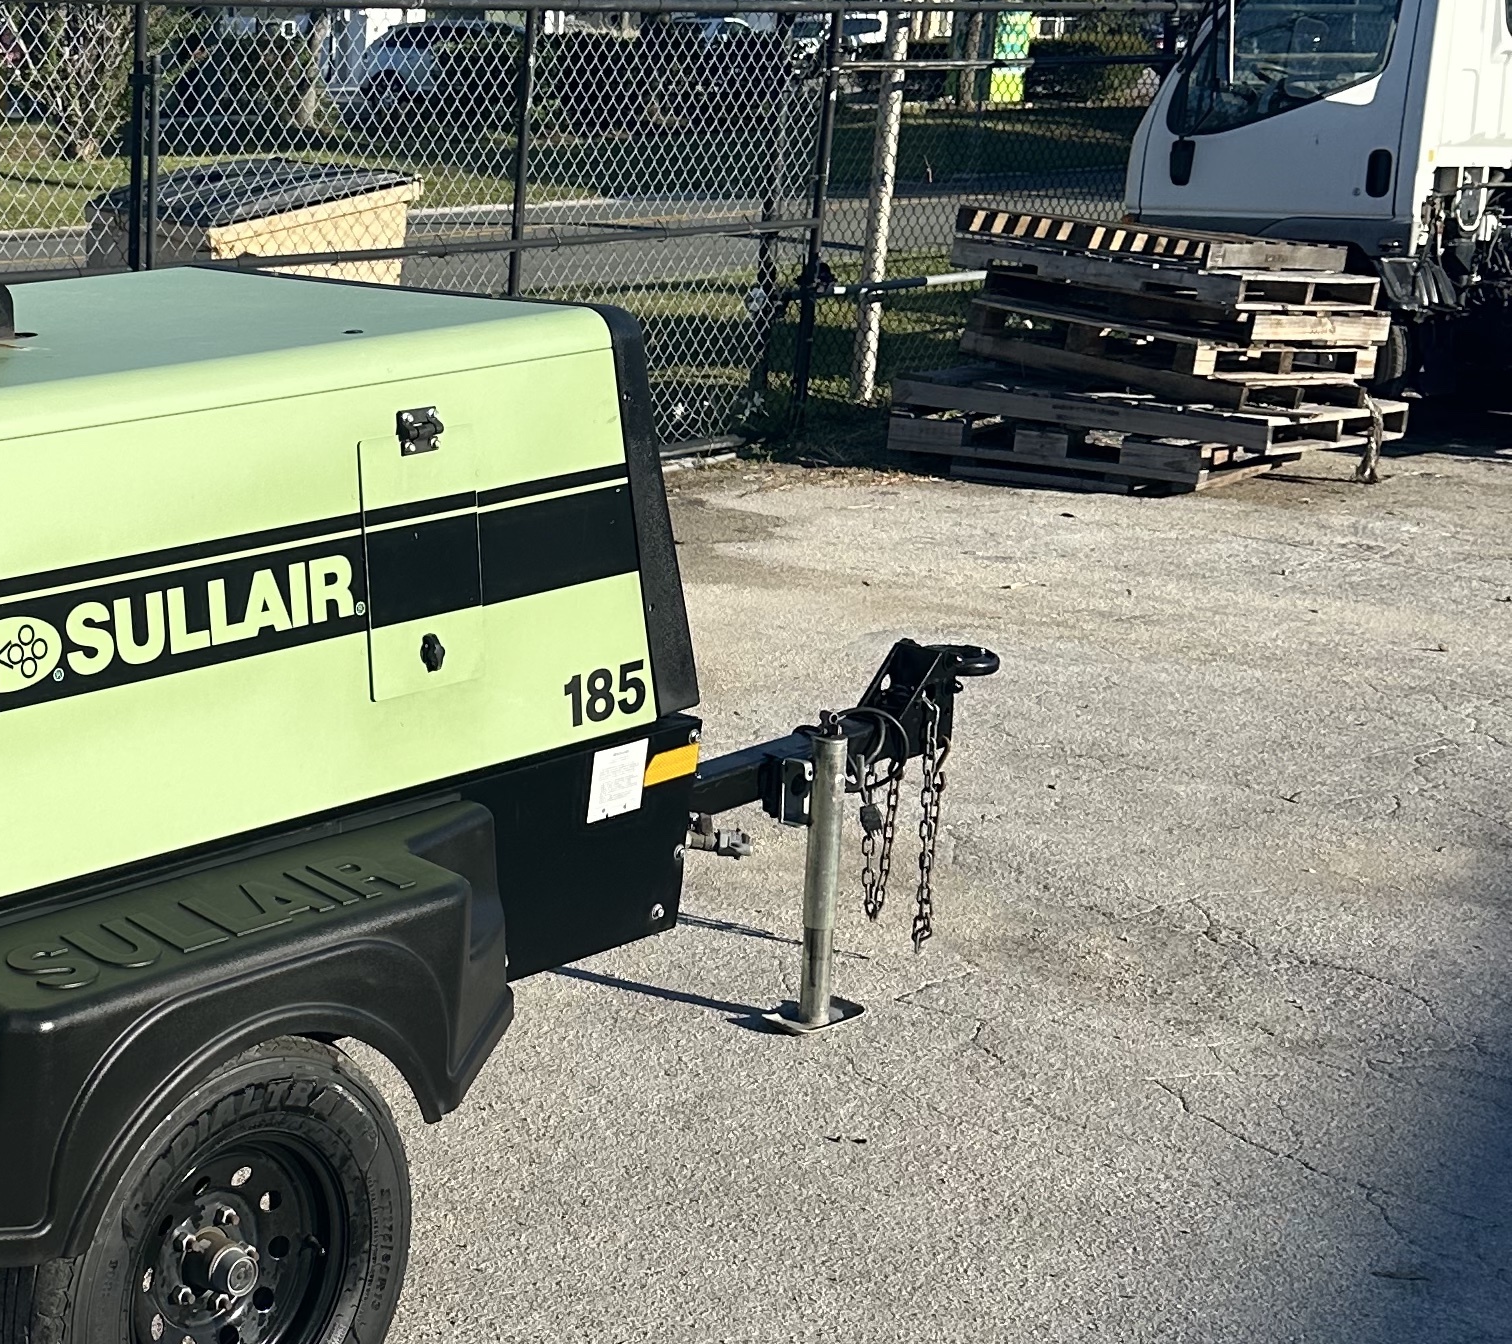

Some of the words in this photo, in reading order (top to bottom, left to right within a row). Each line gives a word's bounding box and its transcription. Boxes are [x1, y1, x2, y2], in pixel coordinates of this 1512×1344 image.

[65, 554, 355, 676] SULLAIR
[564, 659, 646, 727] 185
[6, 858, 416, 989] SULLAIR
[127, 1083, 261, 1226] RADIAL
